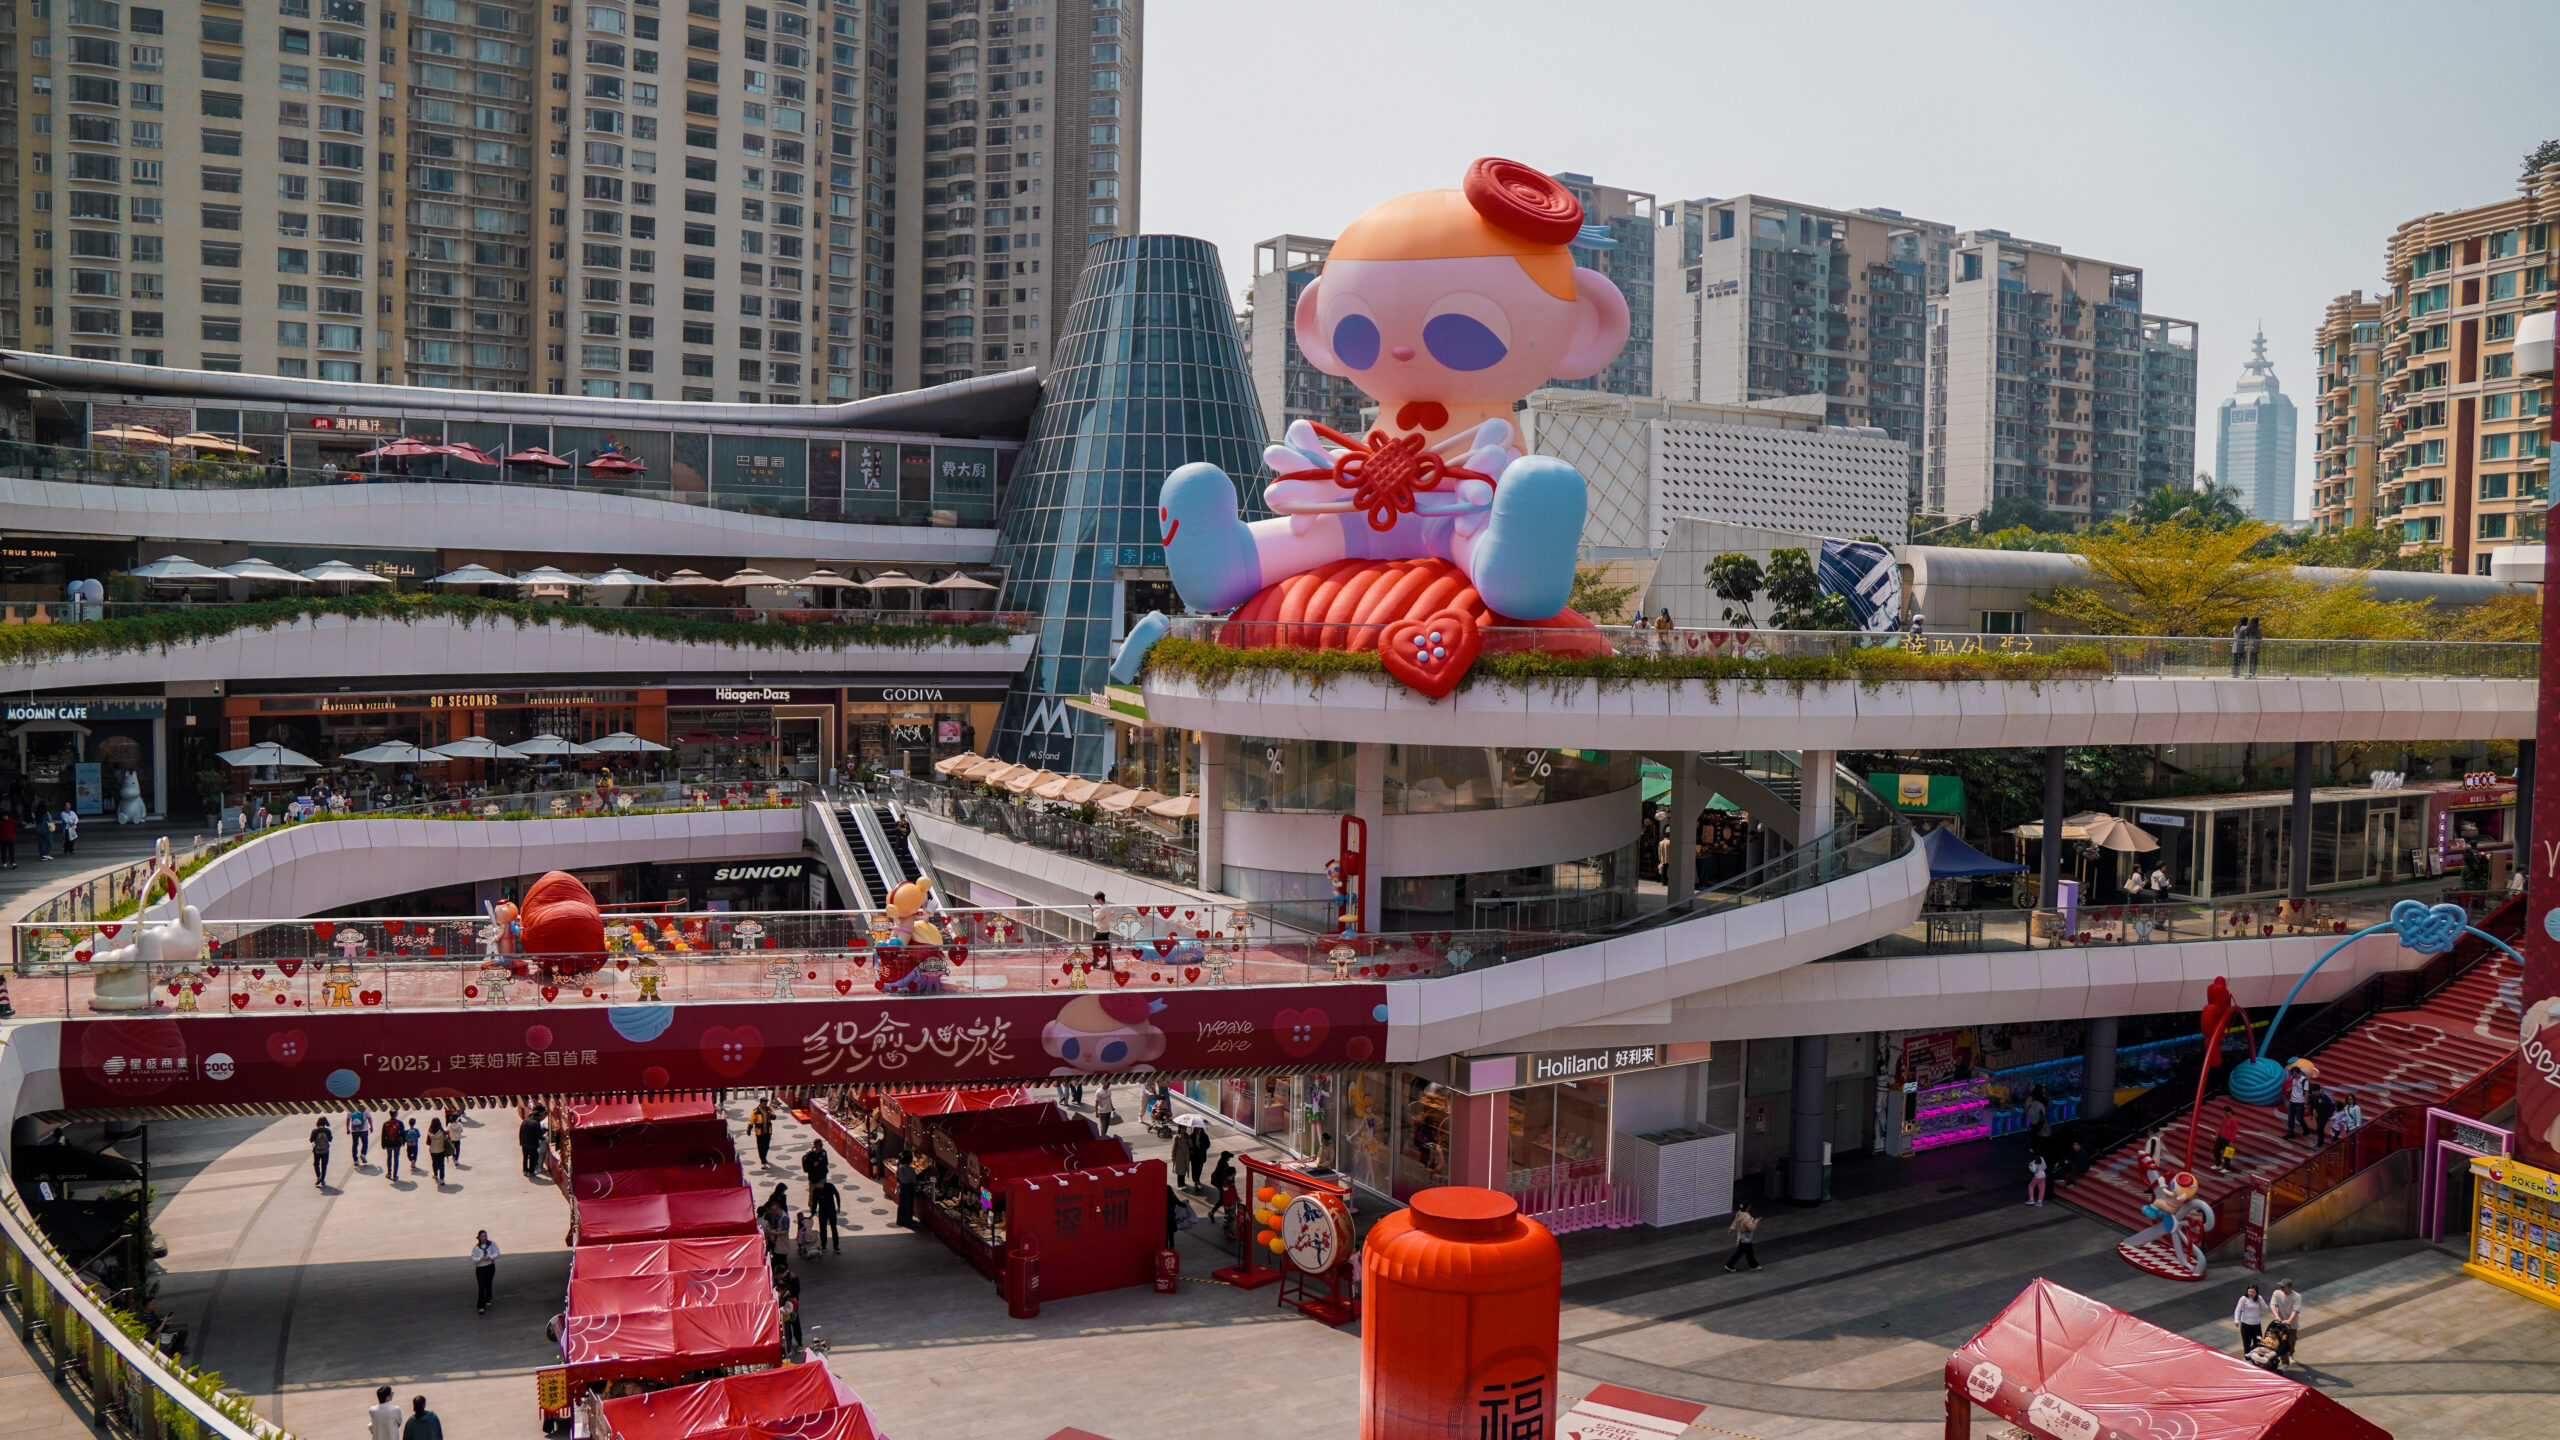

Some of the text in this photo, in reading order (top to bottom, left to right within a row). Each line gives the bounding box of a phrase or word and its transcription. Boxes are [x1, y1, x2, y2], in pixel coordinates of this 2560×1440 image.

[942, 461, 987, 478] 费大厨
[1934, 636, 2014, 651] TEA 2F
[430, 694, 498, 708] 90 SECONDS
[882, 689, 943, 701] GODIVA
[8, 707, 87, 720] MOOMIN CAFE
[714, 865, 803, 880] SUNION
[1537, 1047, 1655, 1079] Holiland 好利来
[1055, 1188, 1130, 1205] Shen Zhen
[1479, 1374, 1545, 1440] 福
